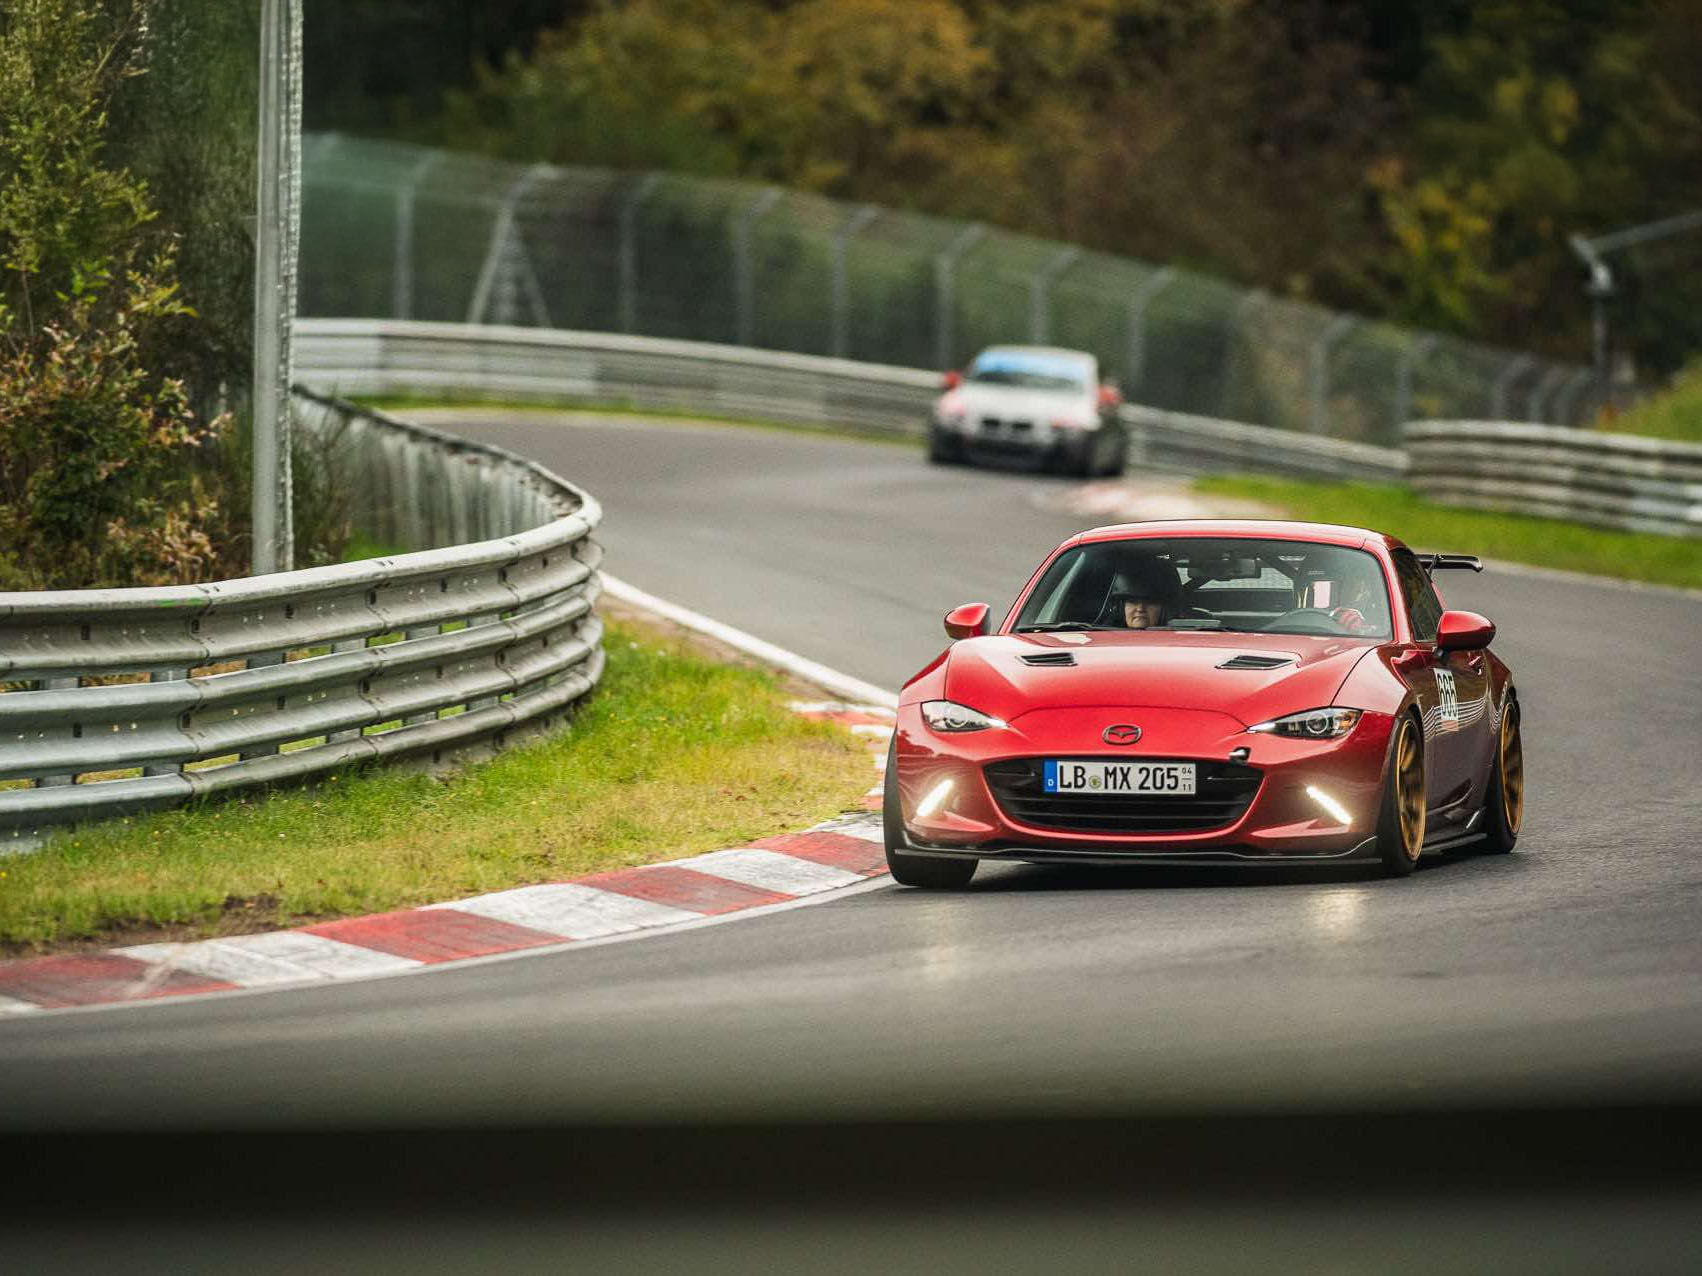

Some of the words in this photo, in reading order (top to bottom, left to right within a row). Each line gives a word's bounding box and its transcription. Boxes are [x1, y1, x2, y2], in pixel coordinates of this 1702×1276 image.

[1060, 765, 1086, 789] LB
[1104, 766, 1131, 790] MX
[1138, 767, 1179, 790] 205
[1183, 783, 1191, 792] 11
